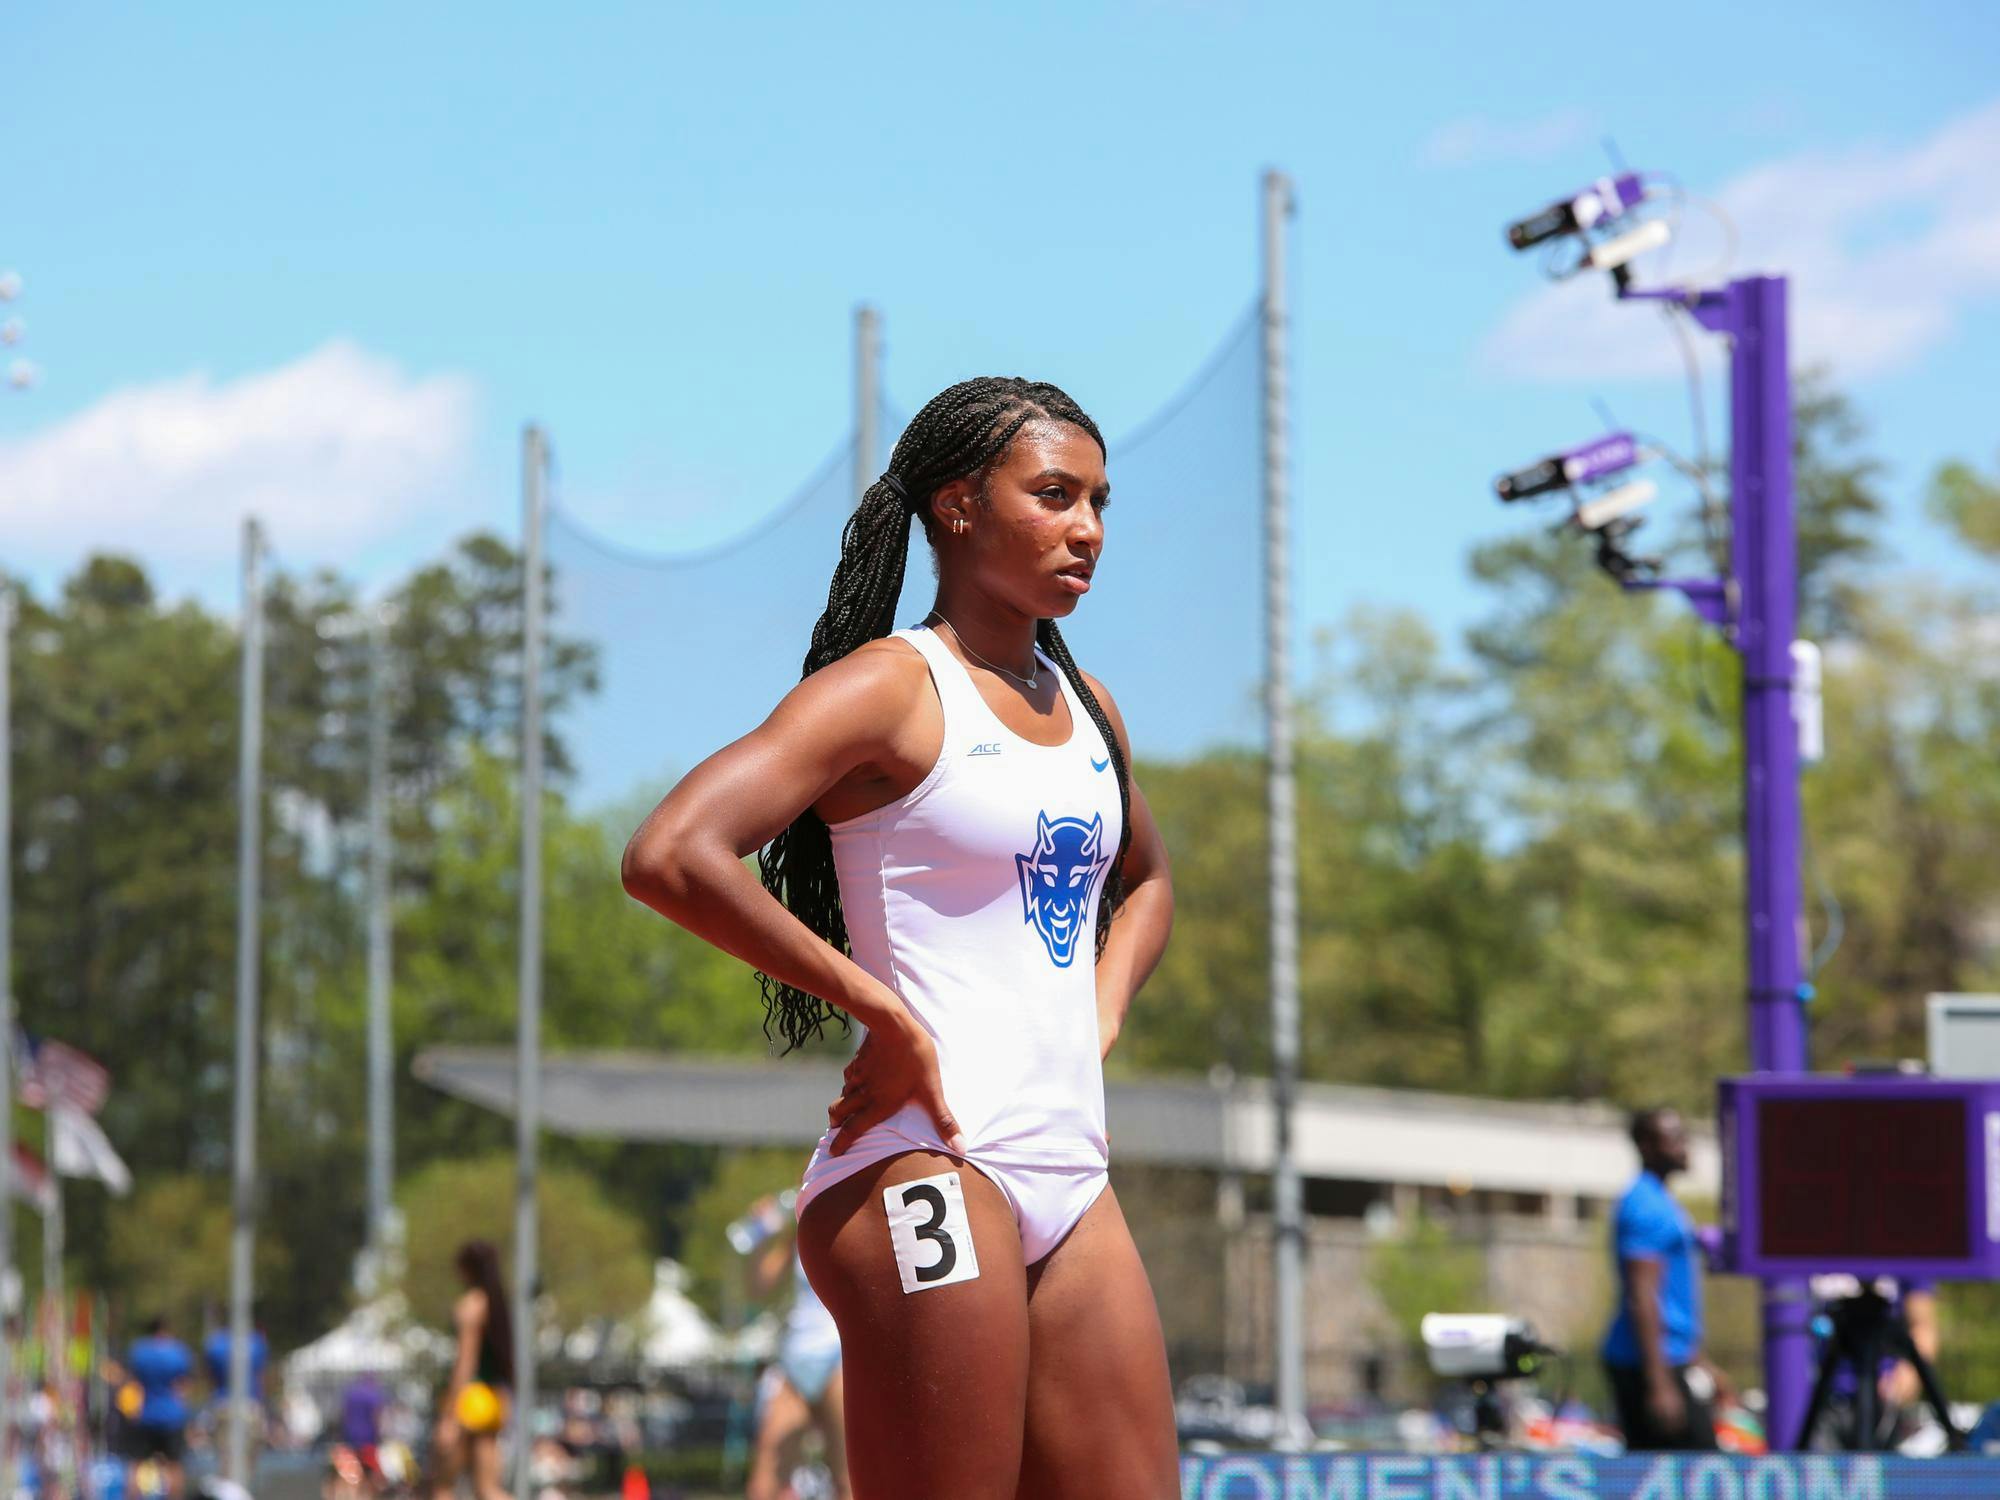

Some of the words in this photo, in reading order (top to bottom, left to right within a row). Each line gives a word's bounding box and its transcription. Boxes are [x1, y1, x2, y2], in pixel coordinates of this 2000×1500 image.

[970, 743, 1001, 753] ACC
[901, 1184, 956, 1282] 3
[1180, 1455, 1599, 1500] OMEN'S
[1630, 1455, 1884, 1500] 400M
